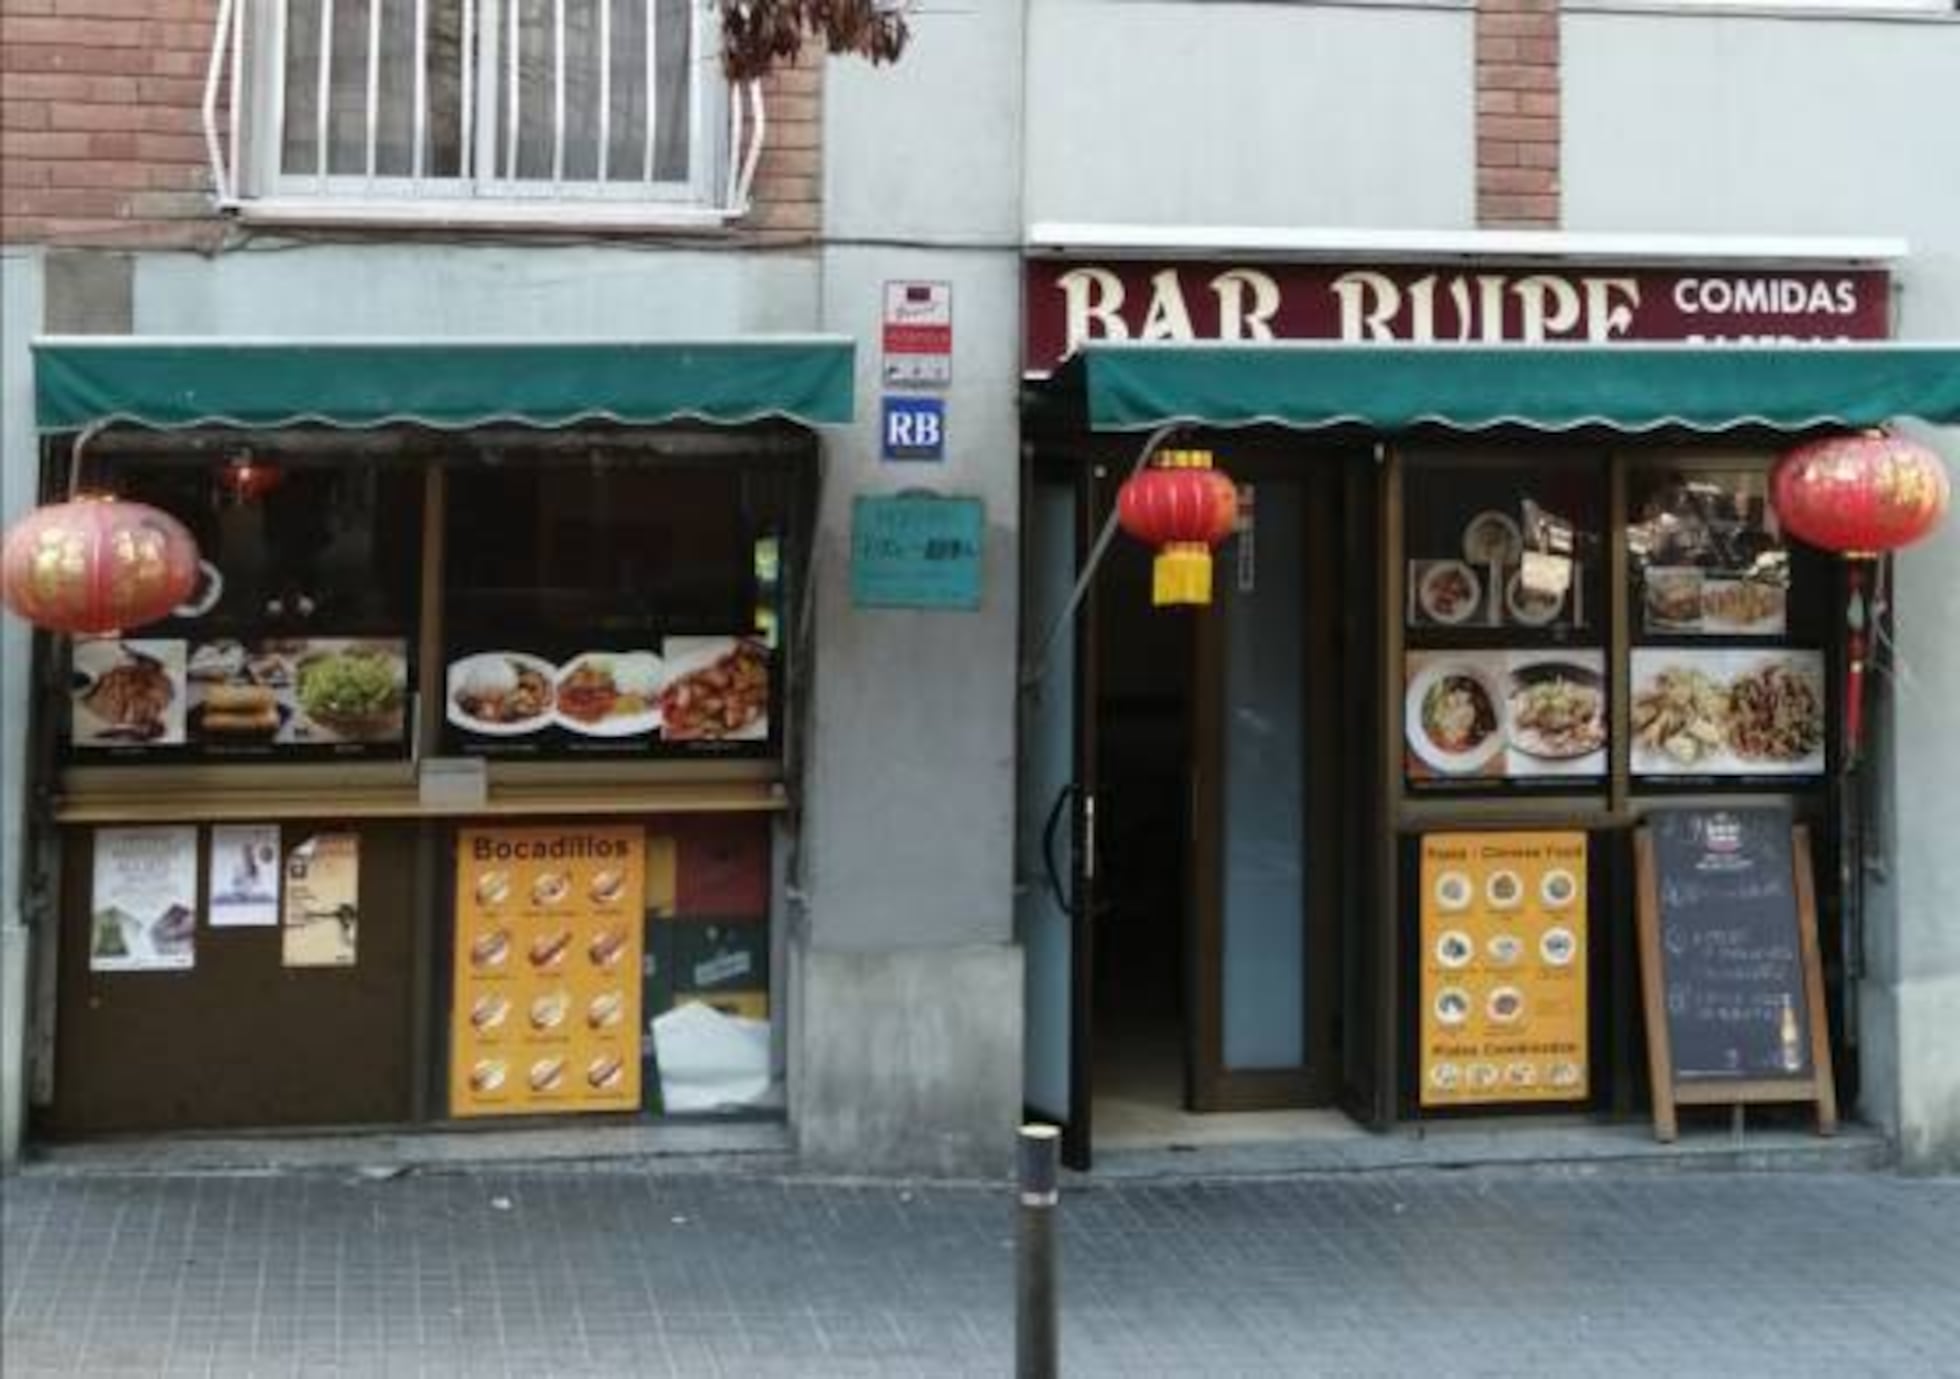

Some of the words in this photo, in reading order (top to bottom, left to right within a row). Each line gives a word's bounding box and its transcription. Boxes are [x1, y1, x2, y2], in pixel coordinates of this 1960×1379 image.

[1056, 267, 1280, 361] BAR
[1674, 278, 1857, 315] COMIDAS
[888, 411, 940, 446] RB
[473, 835, 629, 861] Bocadillos
